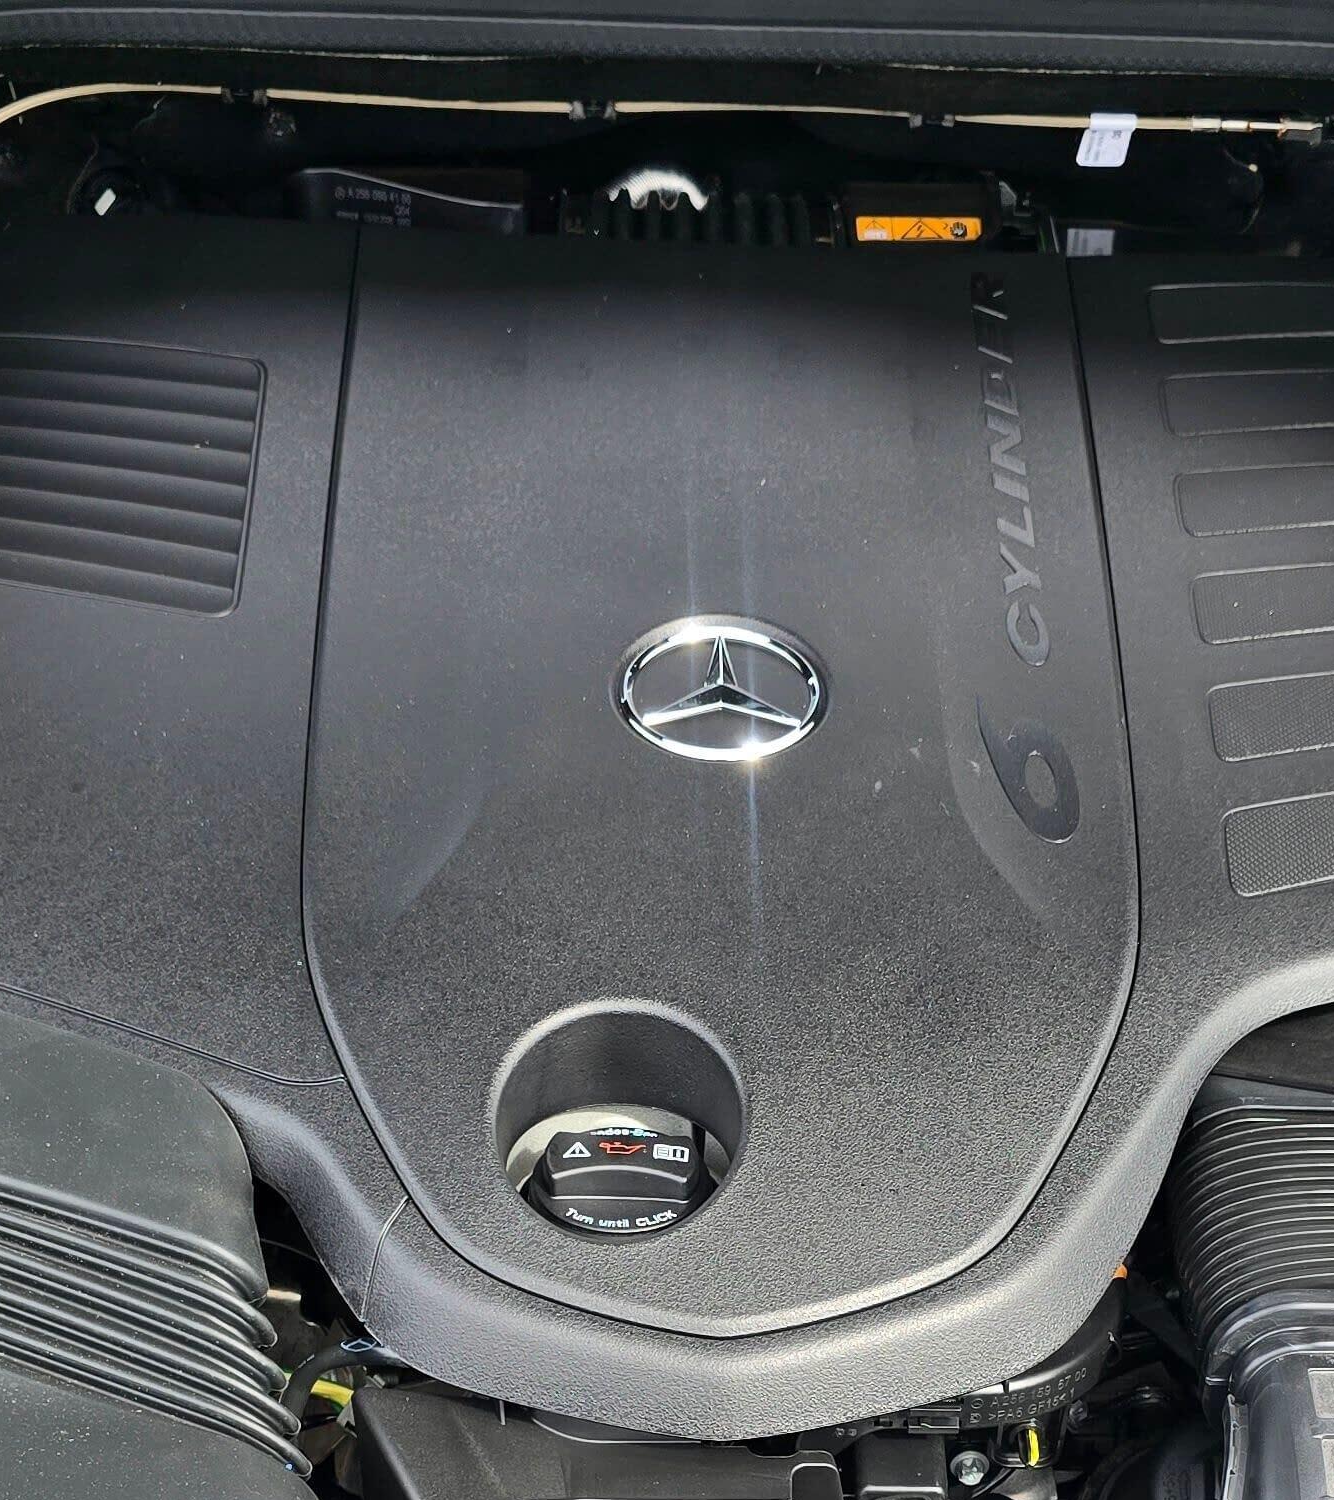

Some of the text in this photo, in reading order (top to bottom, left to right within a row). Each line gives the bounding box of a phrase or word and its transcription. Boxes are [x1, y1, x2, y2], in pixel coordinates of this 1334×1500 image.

[970, 272, 1051, 667] CYLINDER
[566, 1207, 678, 1228] Turn until CLICK
[1075, 1367, 1087, 1382] 00
